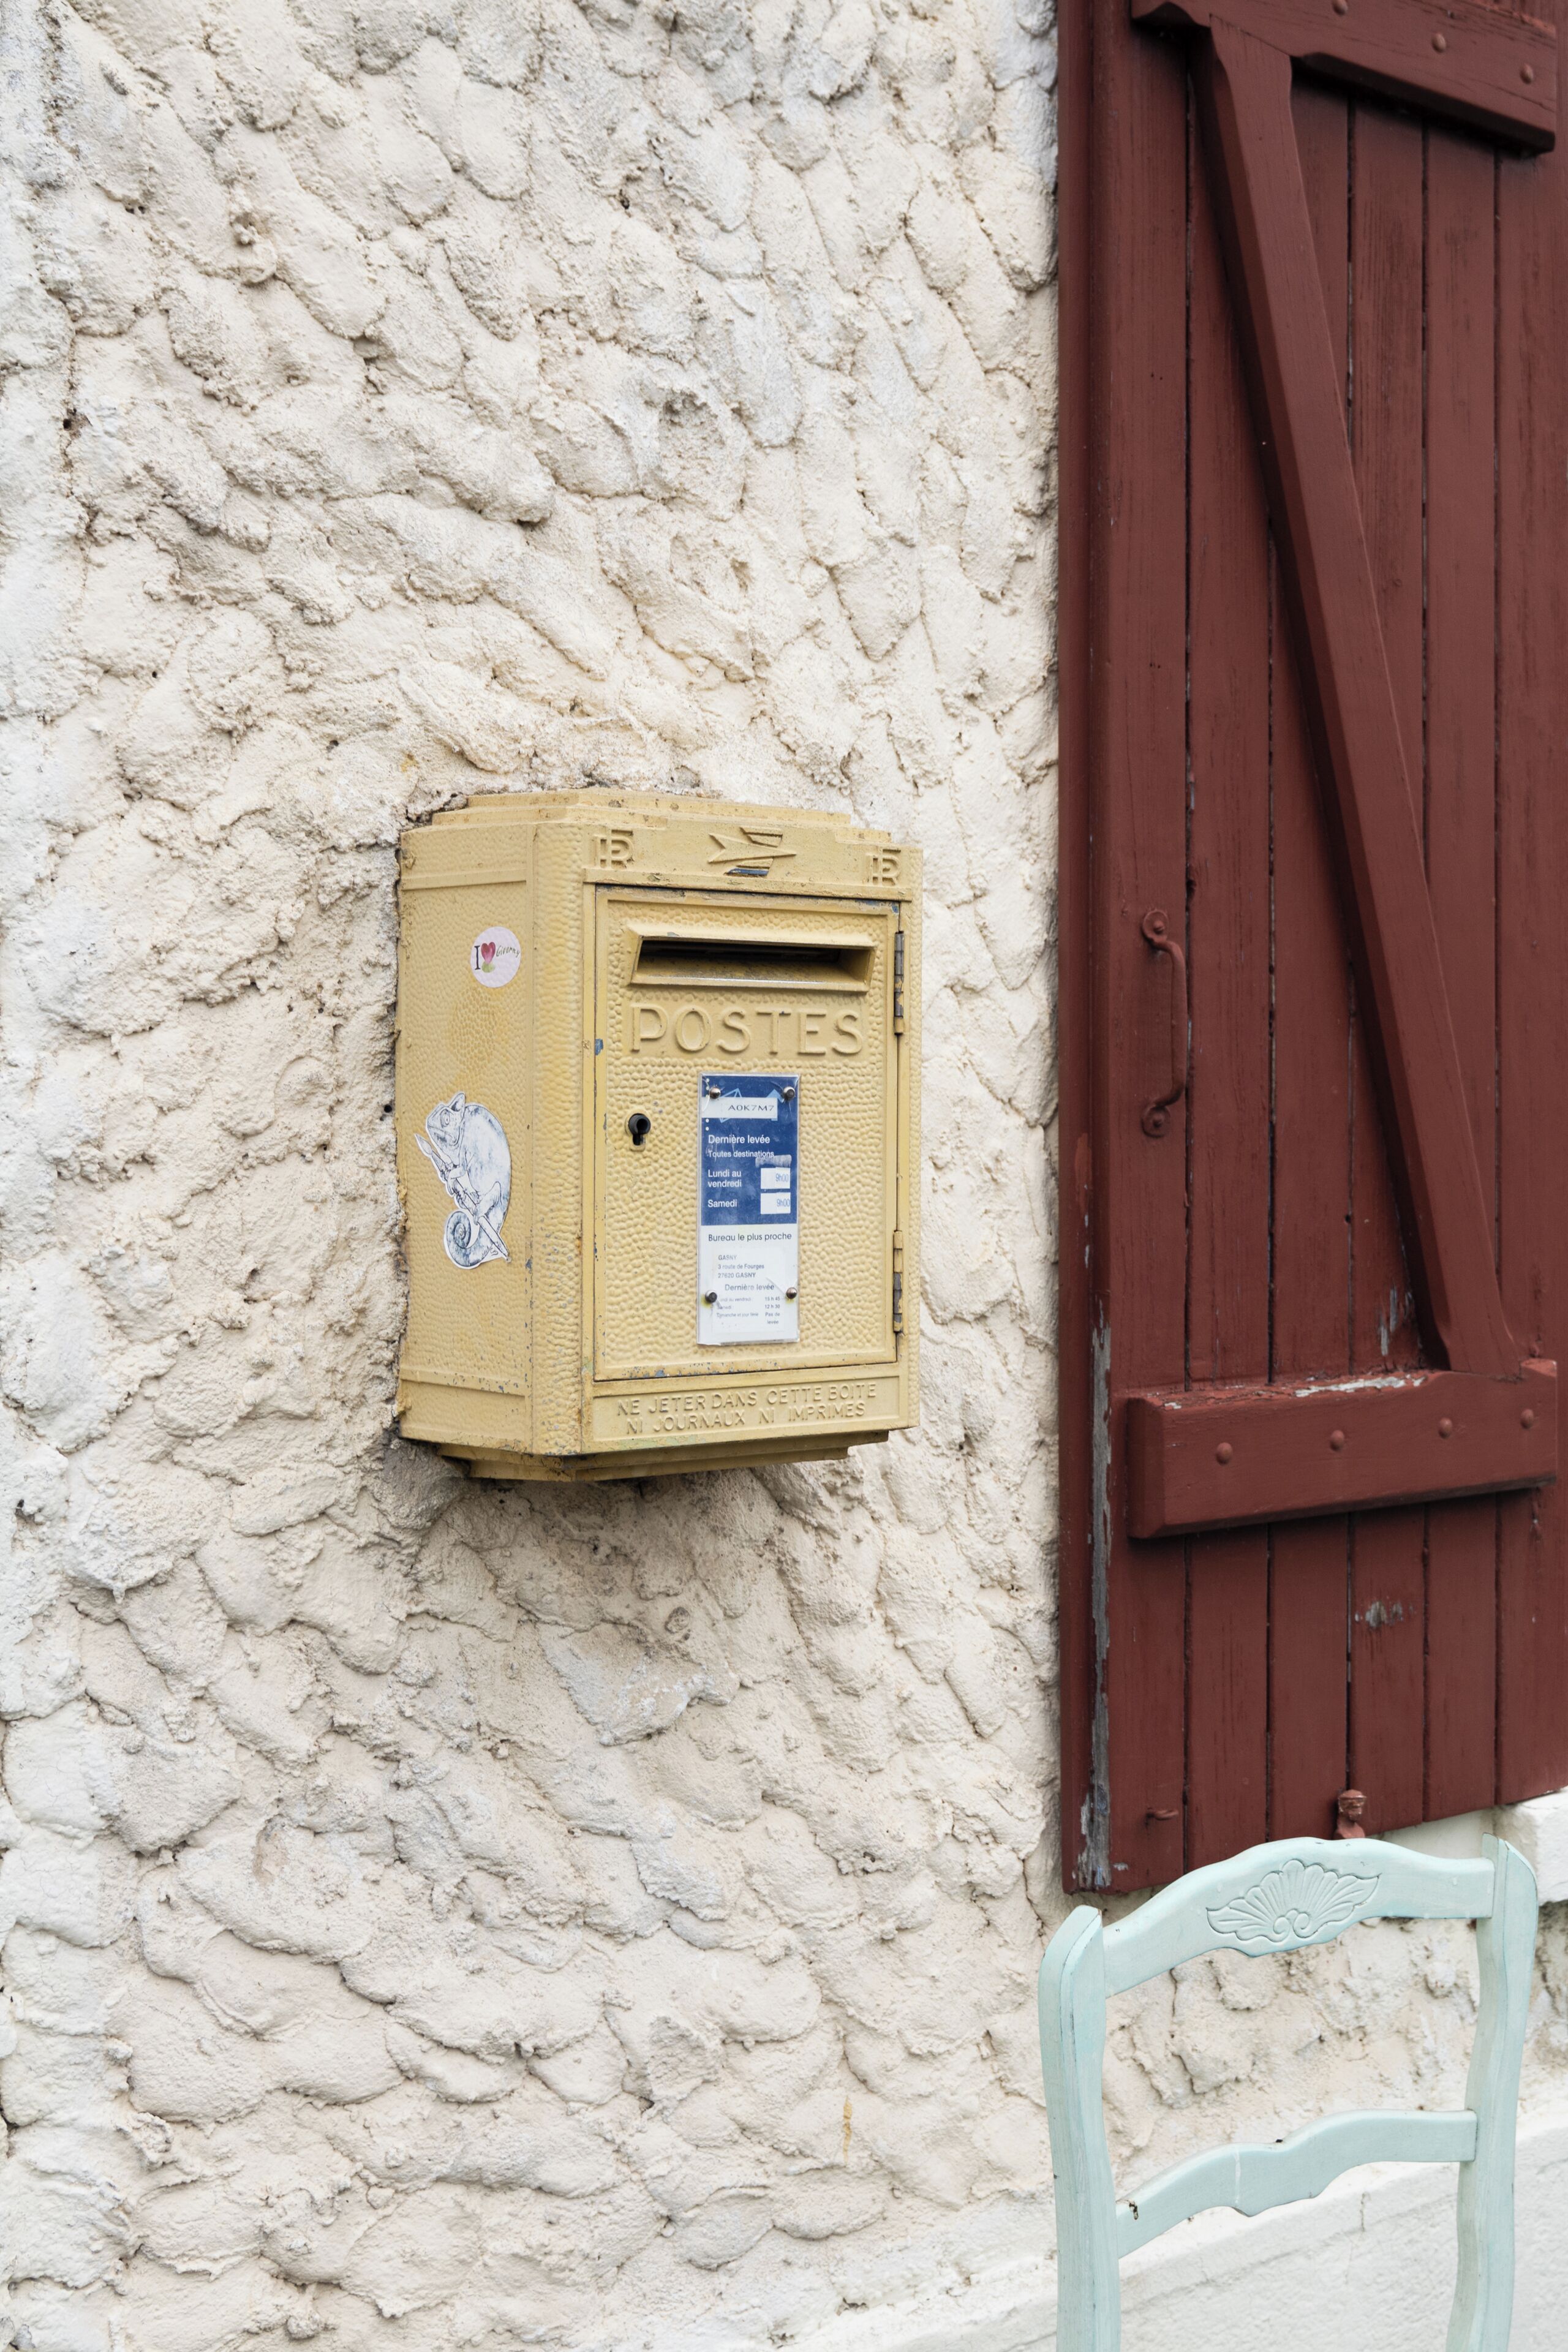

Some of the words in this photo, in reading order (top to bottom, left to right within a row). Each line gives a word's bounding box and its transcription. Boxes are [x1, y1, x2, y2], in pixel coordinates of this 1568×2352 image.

[474, 944, 481, 970] I
[629, 1001, 864, 1055] POSTES
[708, 1134, 745, 1144] Dernière
[747, 1134, 771, 1144] levée
[707, 1169, 730, 1178] Lundi
[707, 1179, 742, 1188] vendredi
[707, 1199, 737, 1208] Samedi
[747, 1233, 763, 1242] plus
[764, 1232, 792, 1242] proche
[617, 1398, 641, 1416] NE
[649, 1393, 706, 1414] JETER
[710, 1390, 758, 1409] DANS
[766, 1385, 823, 1405] CETTE
[828, 1382, 876, 1401] BOITE
[626, 1416, 643, 1435] NI
[652, 1409, 745, 1433] JOURNAUX
[758, 1406, 775, 1424] NI
[788, 1399, 866, 1422] IMPRIMES
